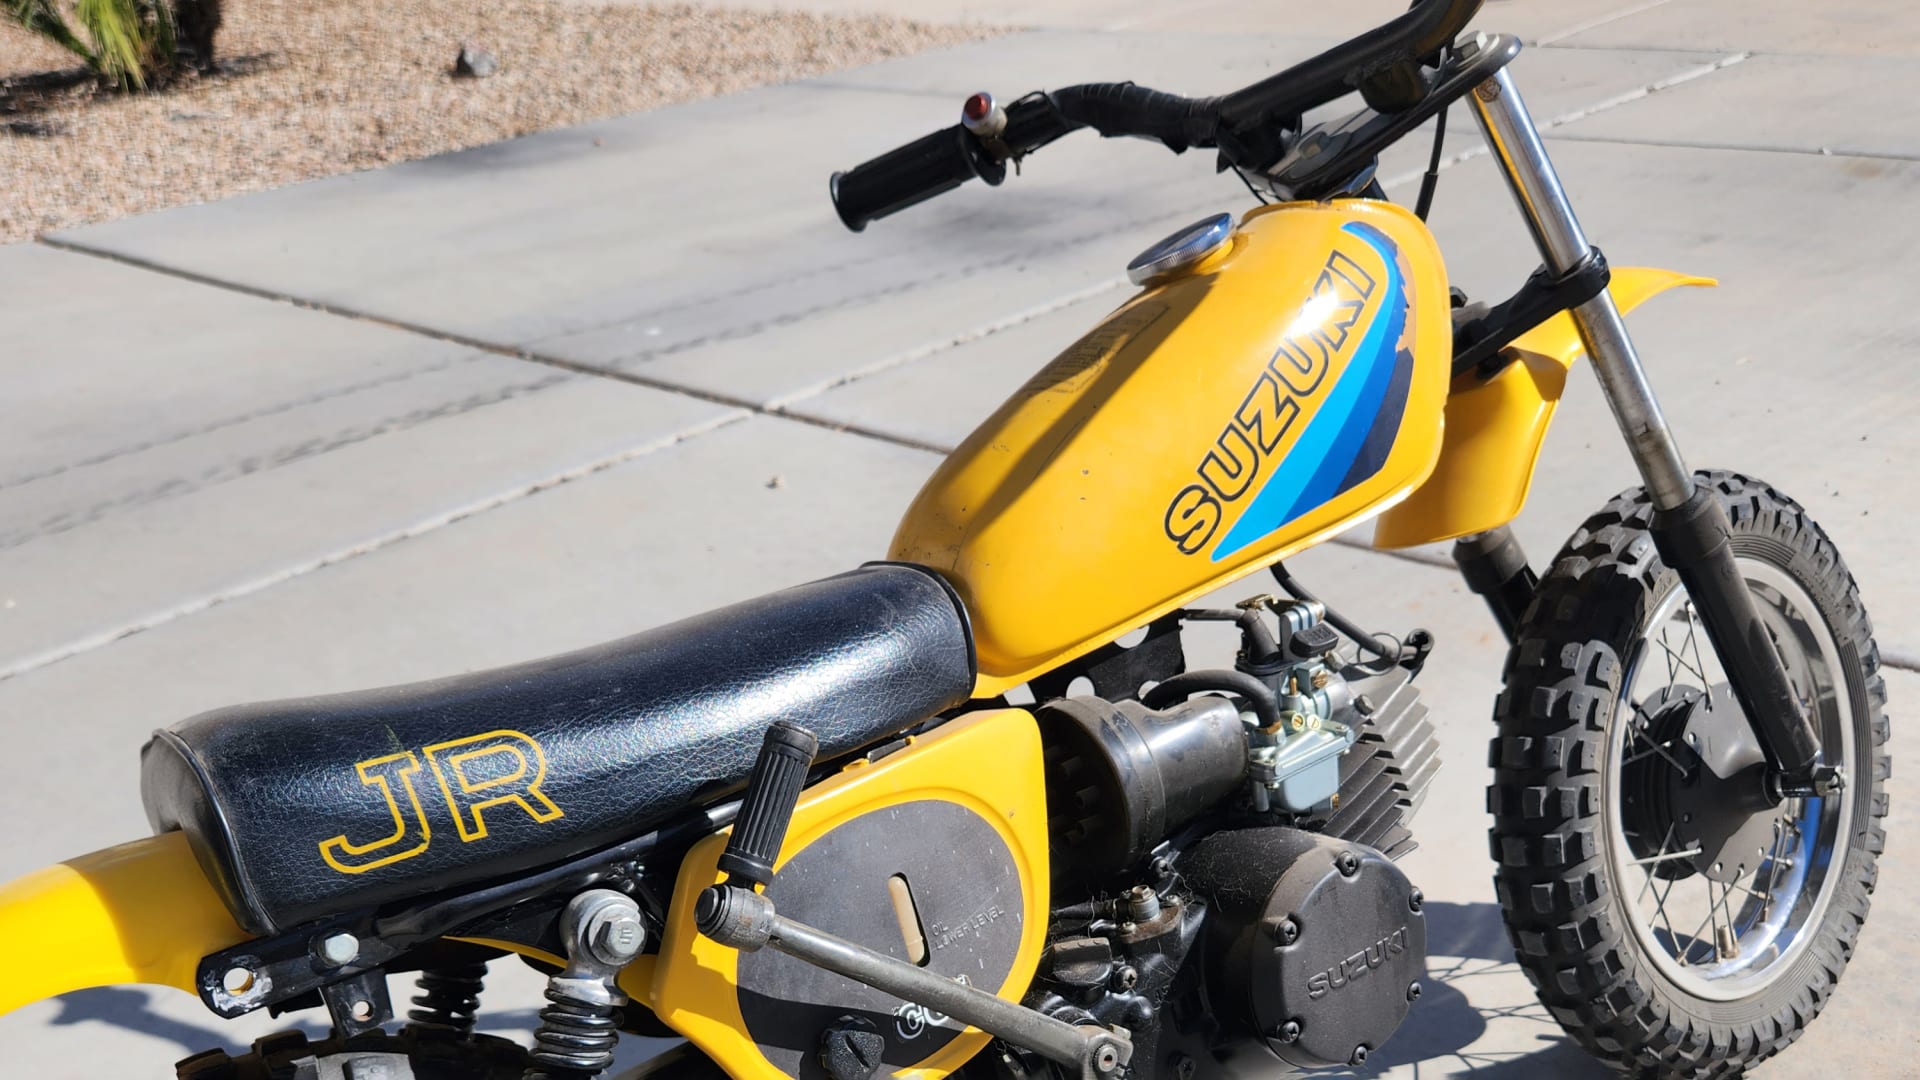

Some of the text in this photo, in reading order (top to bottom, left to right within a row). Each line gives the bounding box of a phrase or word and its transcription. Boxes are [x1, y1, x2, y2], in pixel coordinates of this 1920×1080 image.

[1164, 249, 1376, 555] SUZUKI
[319, 729, 565, 874] JR
[931, 920, 949, 936] OIL
[934, 904, 1005, 950] LOWER LEVEL
[1307, 926, 1407, 1000] SUZUKI
